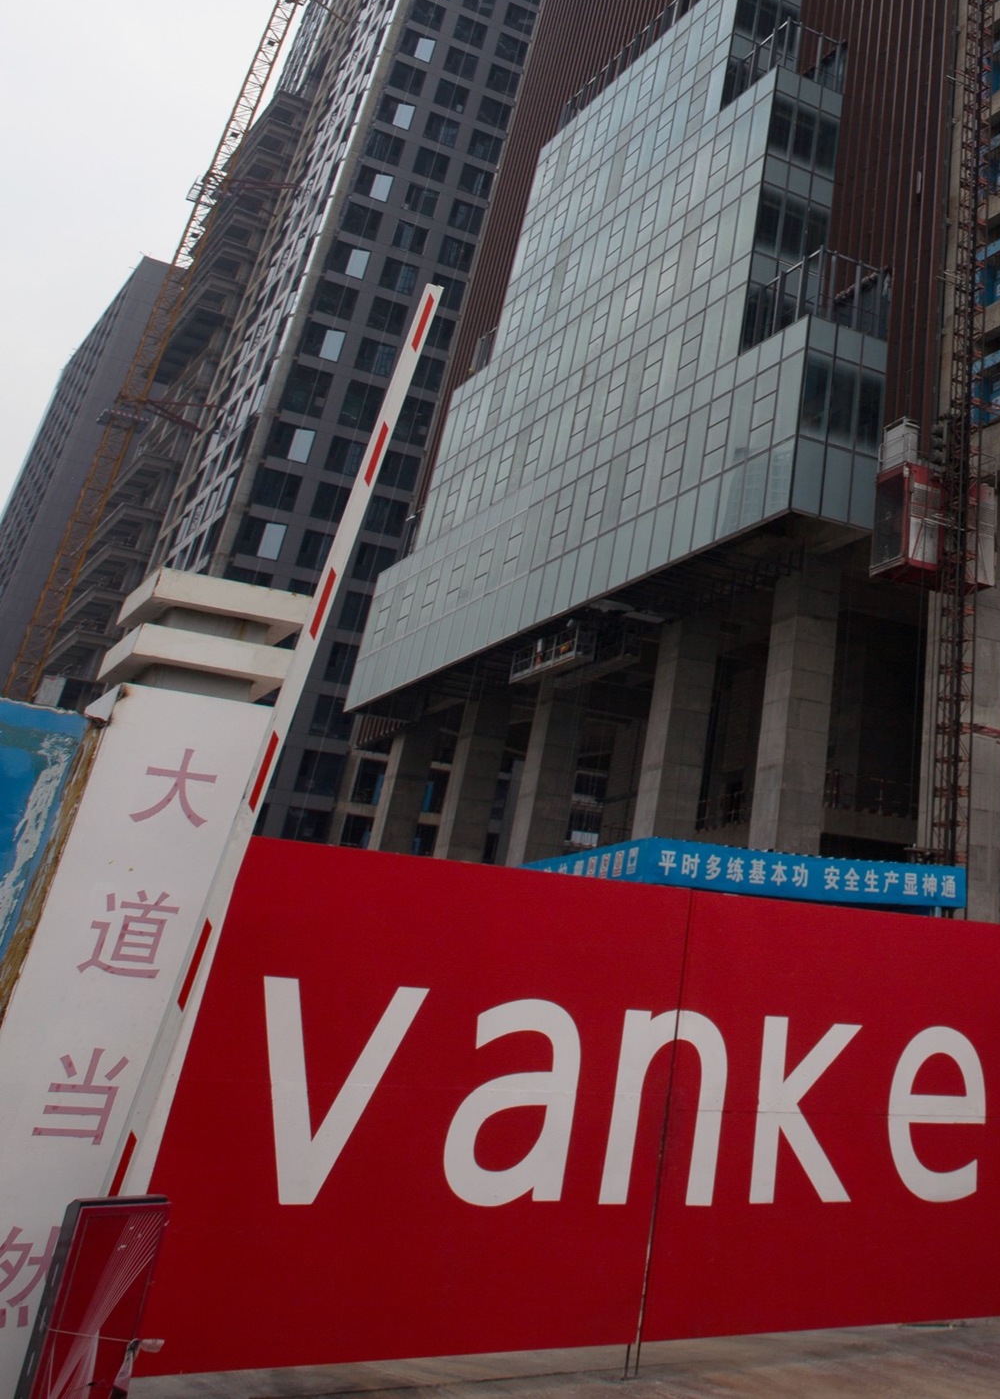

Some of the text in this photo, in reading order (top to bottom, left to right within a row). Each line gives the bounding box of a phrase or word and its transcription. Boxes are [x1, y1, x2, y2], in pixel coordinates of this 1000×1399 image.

[658, 849, 956, 898] 平时多练基本功 安全生产显神通
[263, 975, 986, 1207] vanke
